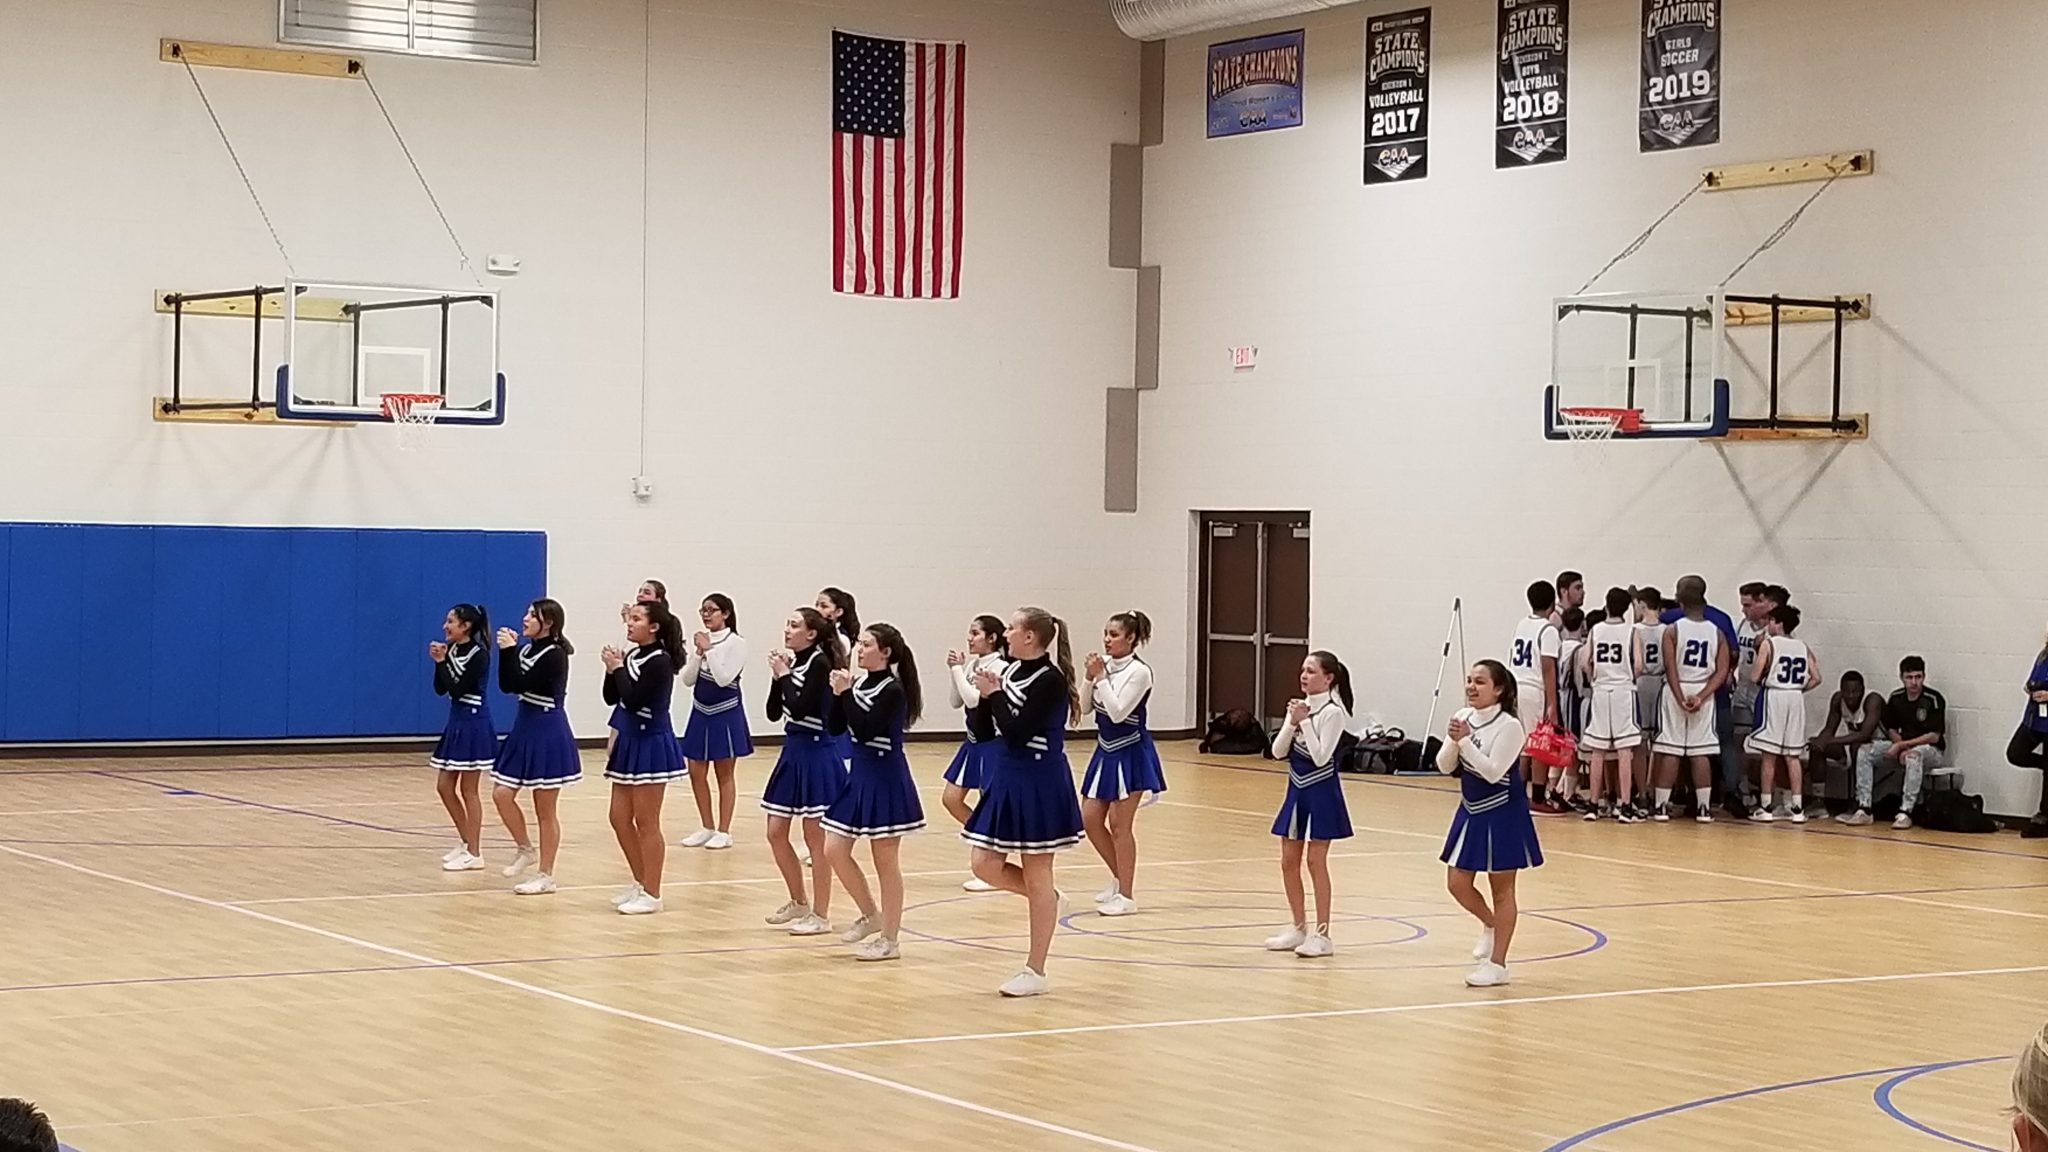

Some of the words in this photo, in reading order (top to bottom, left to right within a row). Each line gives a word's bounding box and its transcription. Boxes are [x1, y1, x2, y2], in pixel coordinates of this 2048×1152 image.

[1509, 7, 1556, 31] STATE
[1646, 2, 1715, 38] CHAMPIONS
[1375, 32, 1419, 54] STATE
[1501, 25, 1564, 61] CHAMPIONS
[1665, 37, 1692, 50] GIRLS
[1212, 56, 1242, 95] STATE
[1244, 46, 1297, 84] CHAMPIONS
[1370, 49, 1426, 81] CHAMPIONS
[1660, 49, 1699, 67] SOCCER
[1503, 73, 1559, 93] VOLLEYBALL
[1648, 69, 1711, 103] 2019
[1369, 88, 1424, 109] VOLLEYBALL
[1502, 90, 1560, 122] 2018
[1371, 107, 1421, 137] 2017
[1659, 109, 1695, 134] CAA
[1513, 128, 1546, 150] CAA
[1379, 147, 1409, 166] CAA
[1511, 638, 1533, 668] 34
[1596, 642, 1623, 664] 23
[1645, 643, 1659, 664] 2
[1683, 639, 1709, 668] 21
[1776, 656, 1806, 684] 32
